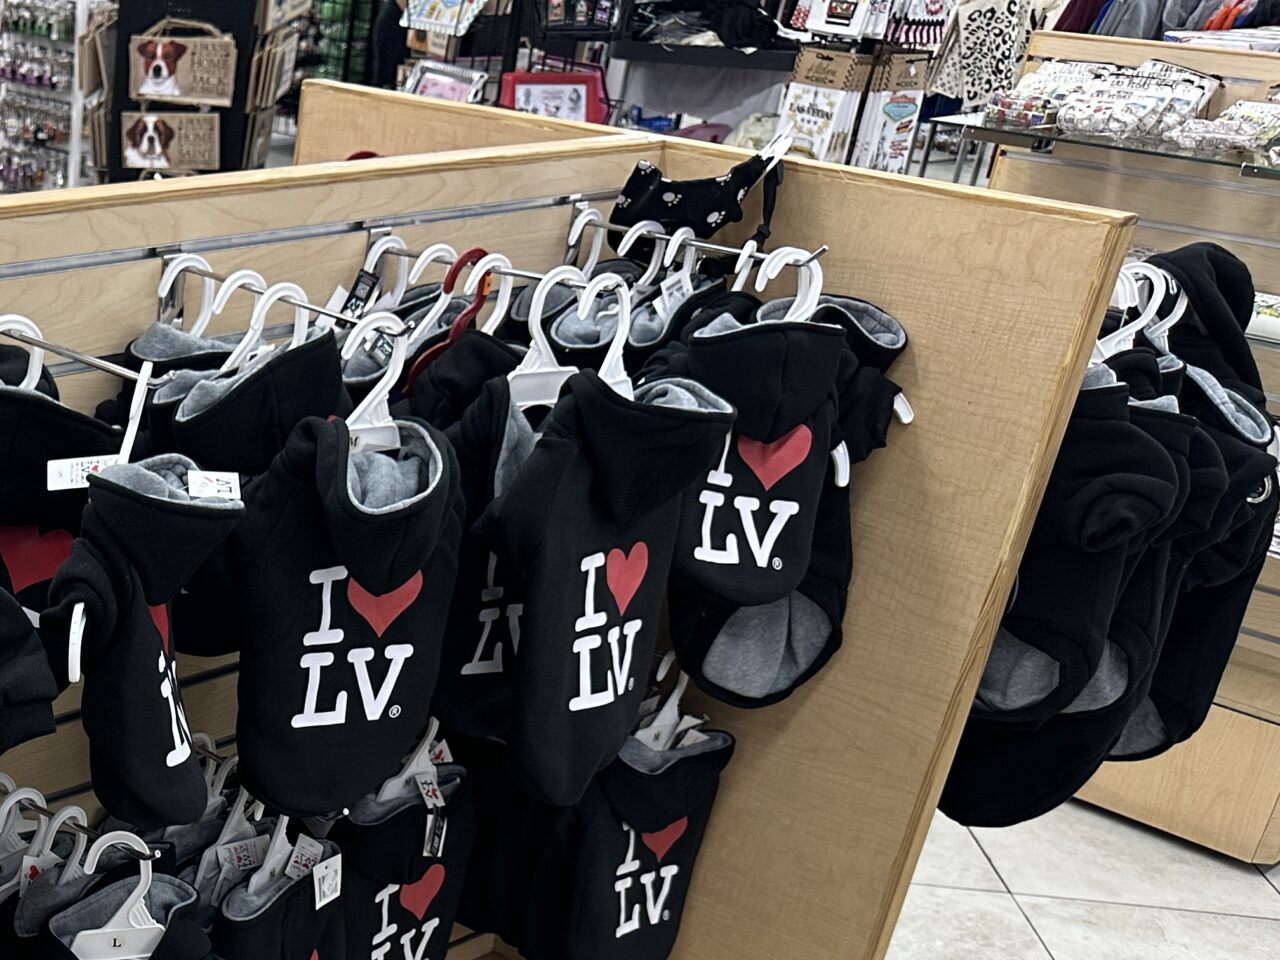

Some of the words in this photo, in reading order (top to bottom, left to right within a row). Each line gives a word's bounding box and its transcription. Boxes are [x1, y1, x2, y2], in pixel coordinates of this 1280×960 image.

[303, 565, 348, 647] I
[574, 552, 607, 633] I
[112, 938, 122, 948] L
[372, 883, 400, 946] I
